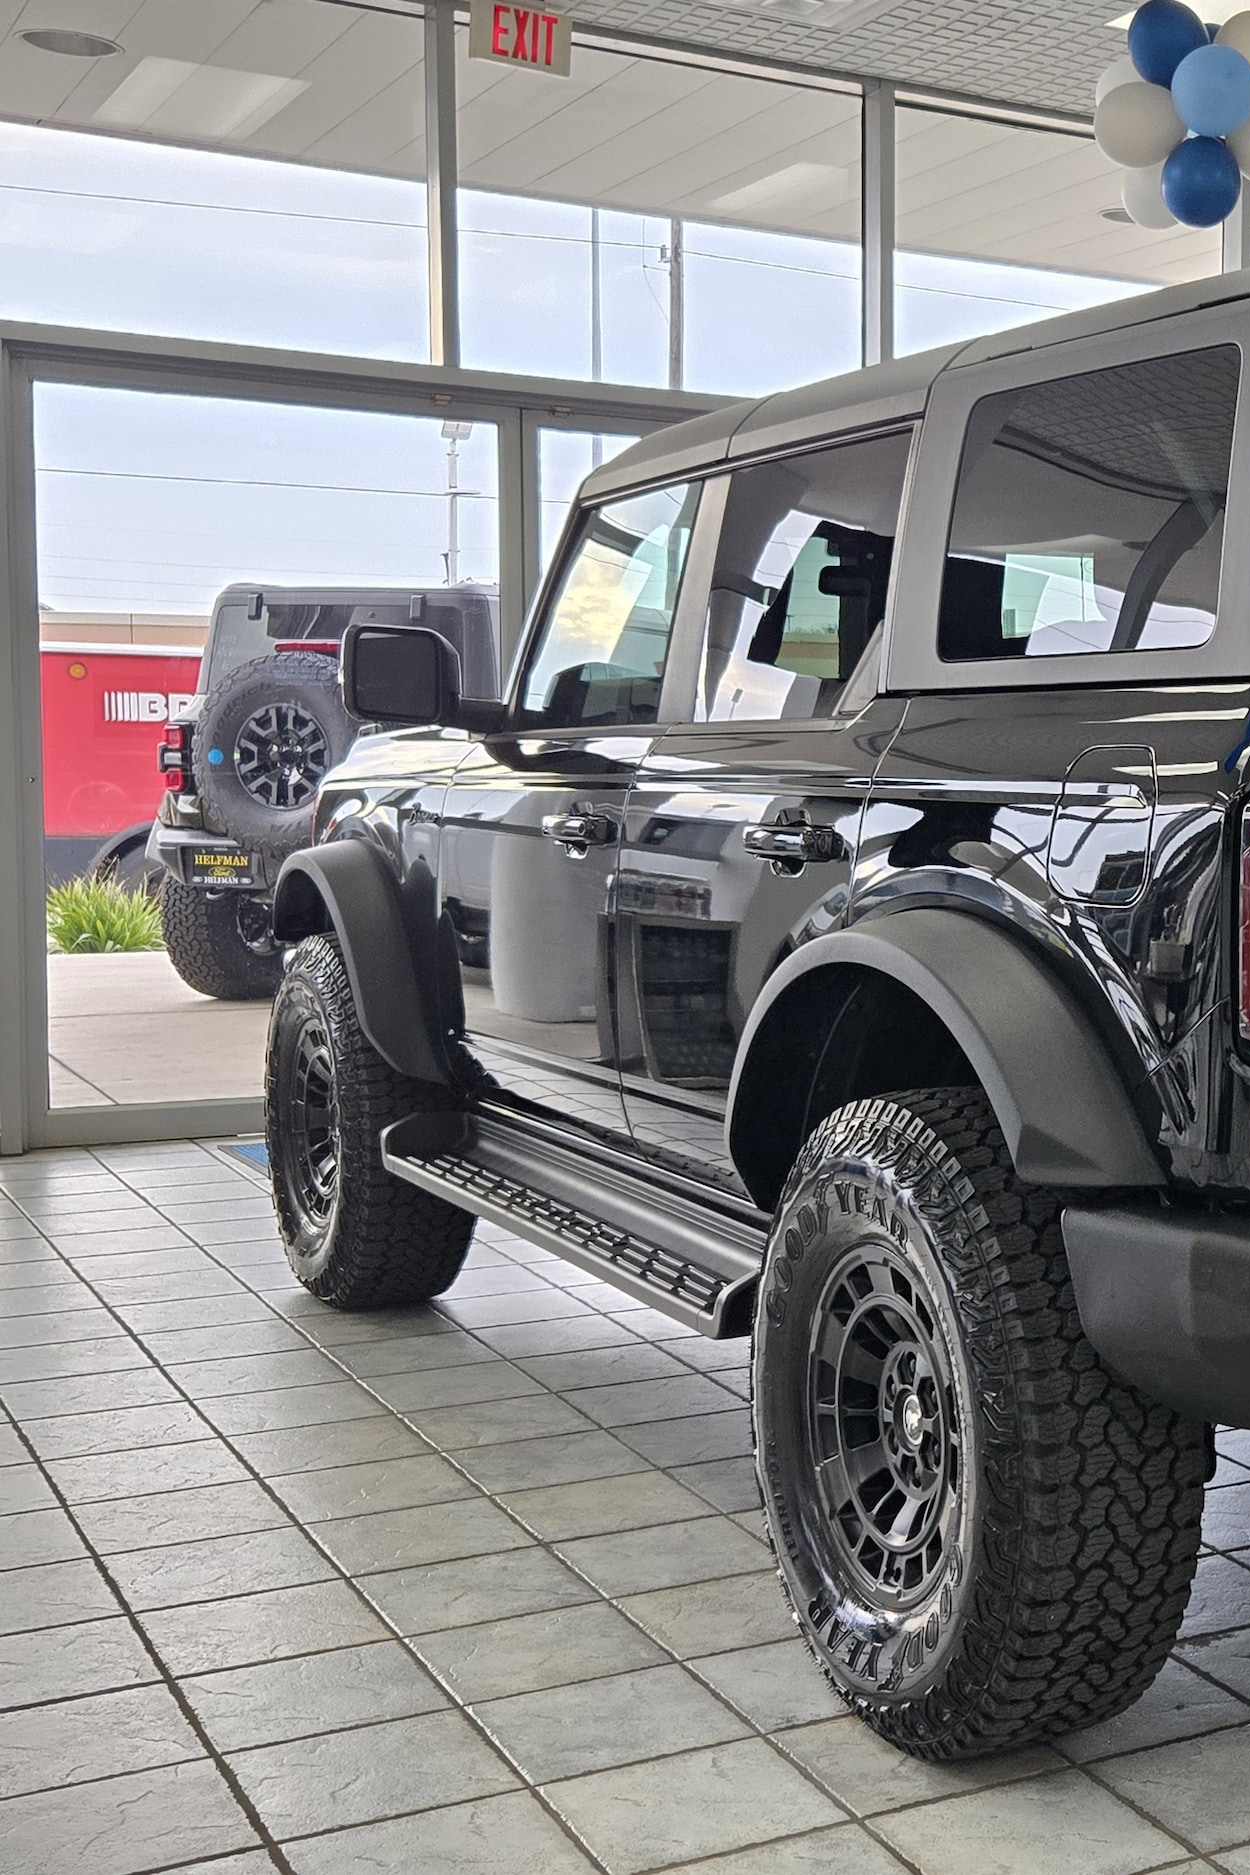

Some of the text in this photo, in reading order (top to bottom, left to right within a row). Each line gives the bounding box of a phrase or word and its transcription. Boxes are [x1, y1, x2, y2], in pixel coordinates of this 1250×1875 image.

[492, 4, 558, 66] EXIT
[194, 854, 249, 867] HELFMAN
[204, 876, 239, 885] HELFMAN
